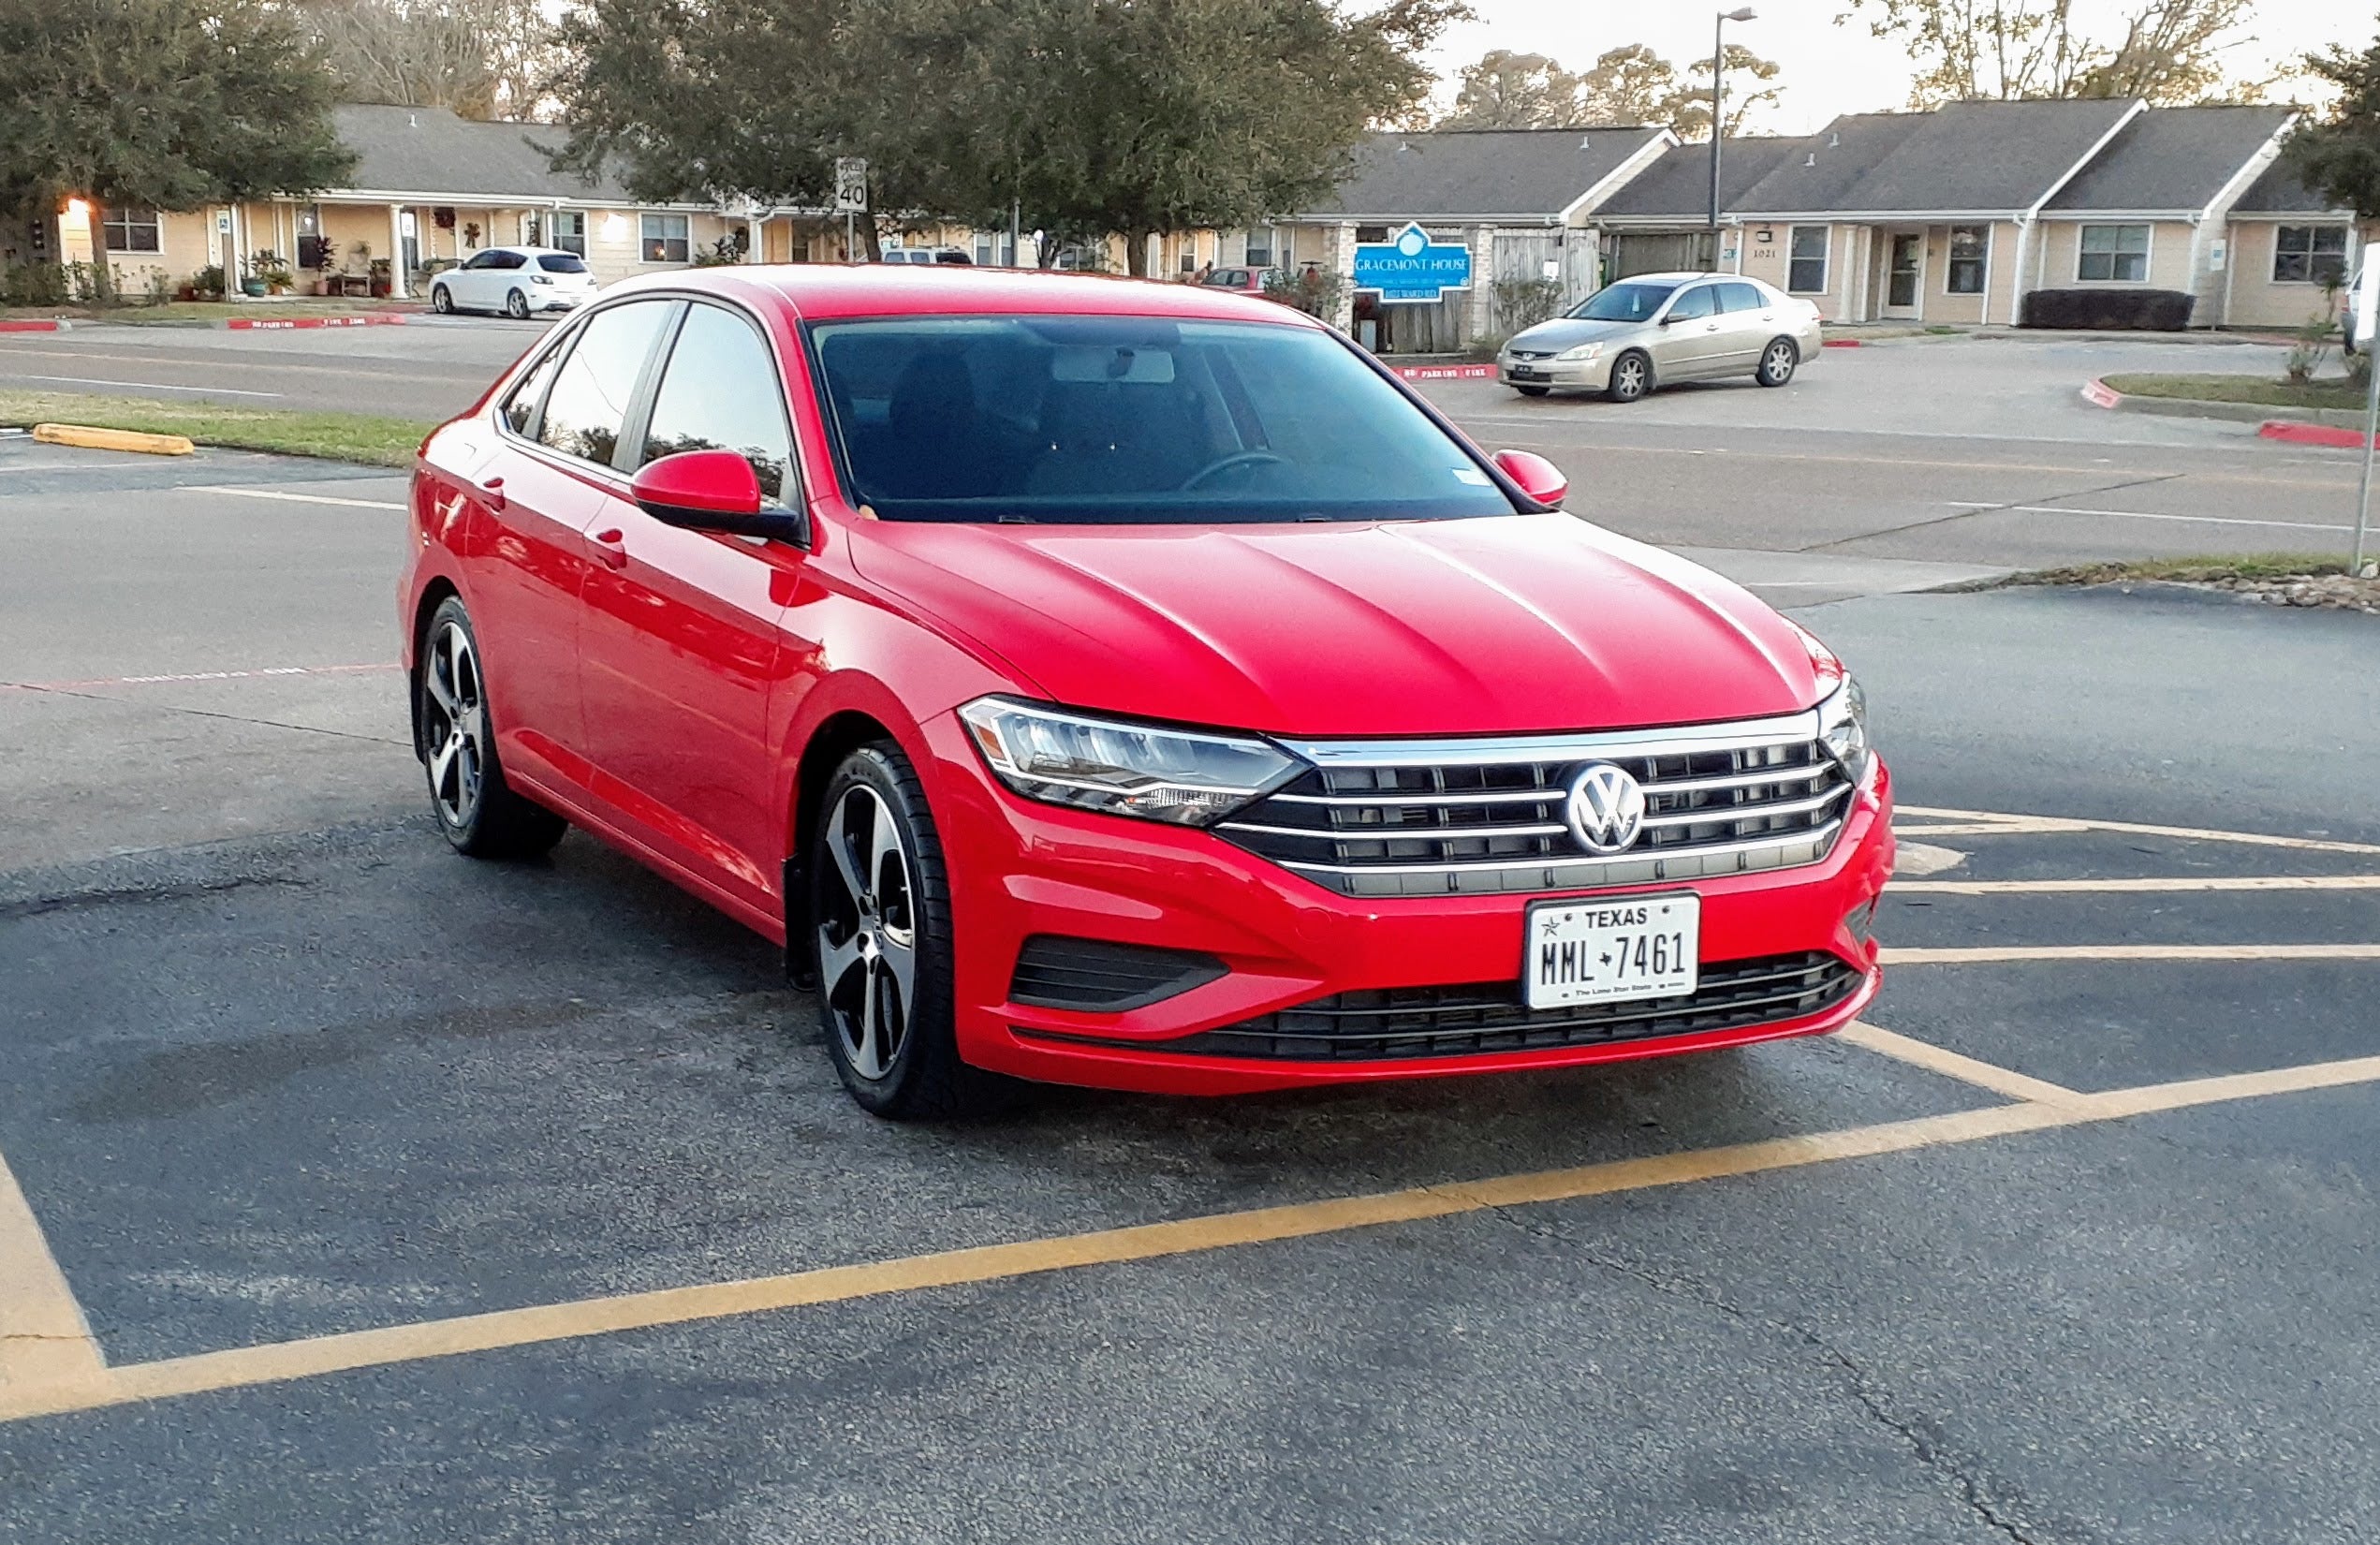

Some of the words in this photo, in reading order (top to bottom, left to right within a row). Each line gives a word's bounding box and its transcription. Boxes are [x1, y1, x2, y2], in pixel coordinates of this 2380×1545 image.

[840, 186, 863, 204] 40
[1754, 249, 1776, 258] 1021
[1355, 258, 1427, 272] GRACEMONT
[1431, 258, 1466, 271] HOUSE
[1585, 907, 1648, 930] TEXAS
[1541, 940, 1595, 985] MML
[1615, 933, 1685, 978] 7461
